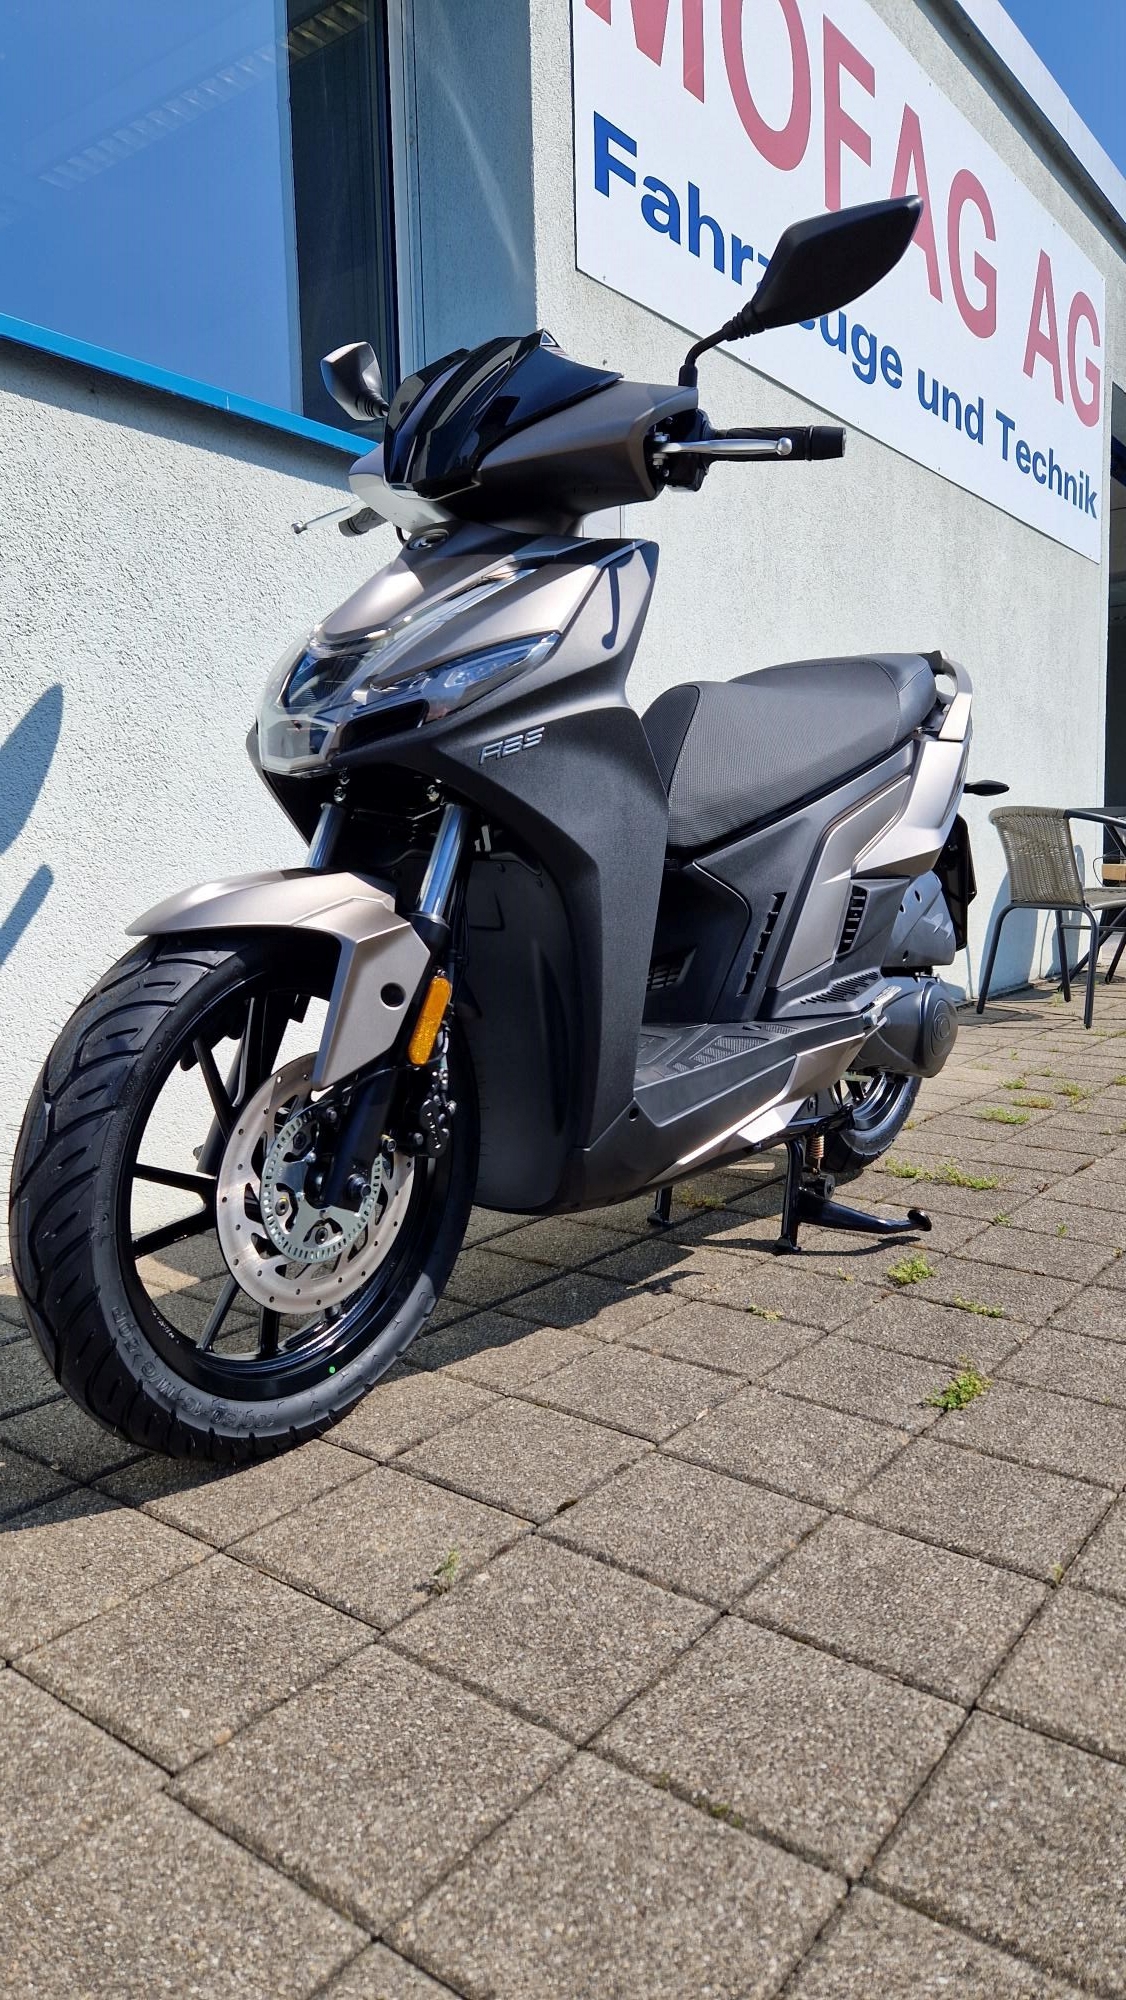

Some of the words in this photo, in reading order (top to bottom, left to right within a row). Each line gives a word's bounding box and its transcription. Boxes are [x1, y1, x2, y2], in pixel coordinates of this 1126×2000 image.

[585, 0, 997, 338] OFAG
[1023, 248, 1100, 427] AG
[593, 111, 903, 390] Fahruge
[917, 368, 984, 445] und
[995, 410, 1098, 520] Technik
[479, 726, 545, 764] ABS
